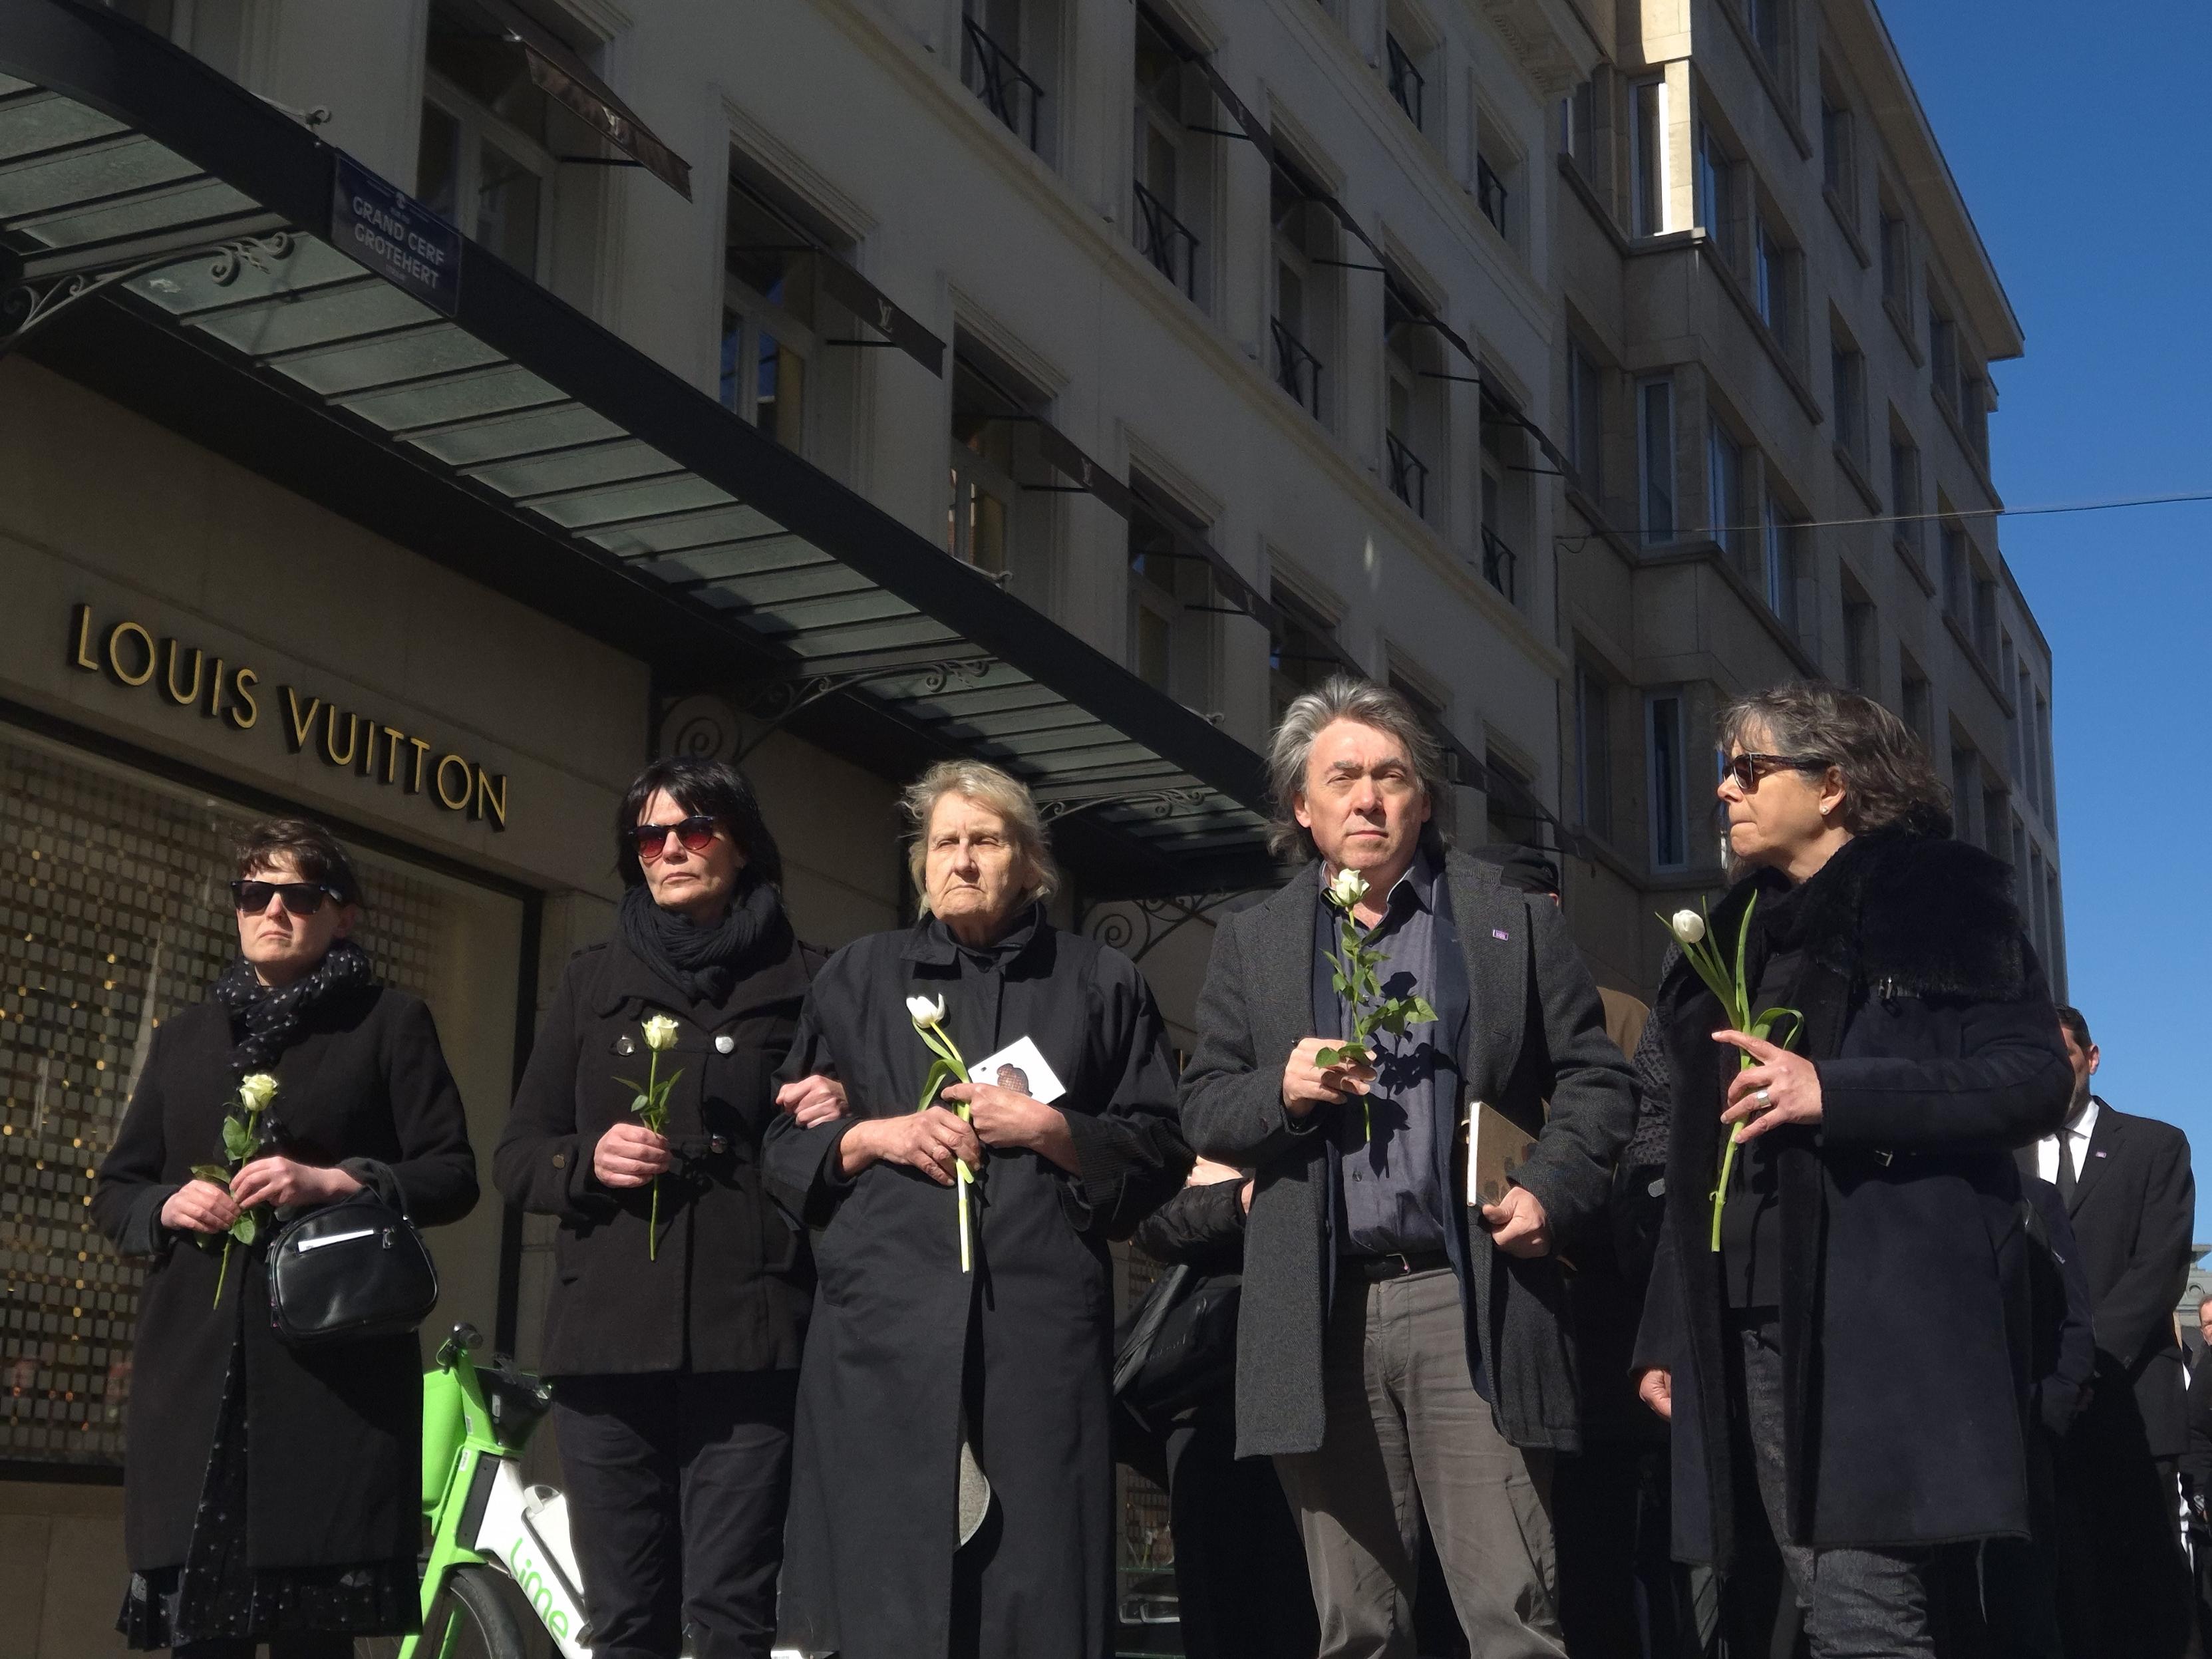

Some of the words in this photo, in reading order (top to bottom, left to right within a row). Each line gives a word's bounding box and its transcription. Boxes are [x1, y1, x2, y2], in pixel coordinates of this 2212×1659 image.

[353, 196, 404, 241] GRAND
[407, 232, 445, 265] CERF
[354, 223, 439, 289] GROTEHERT
[75, 603, 259, 729] LOUIS
[282, 686, 507, 831] VUITTON
[509, 1537, 568, 1640] Lime
